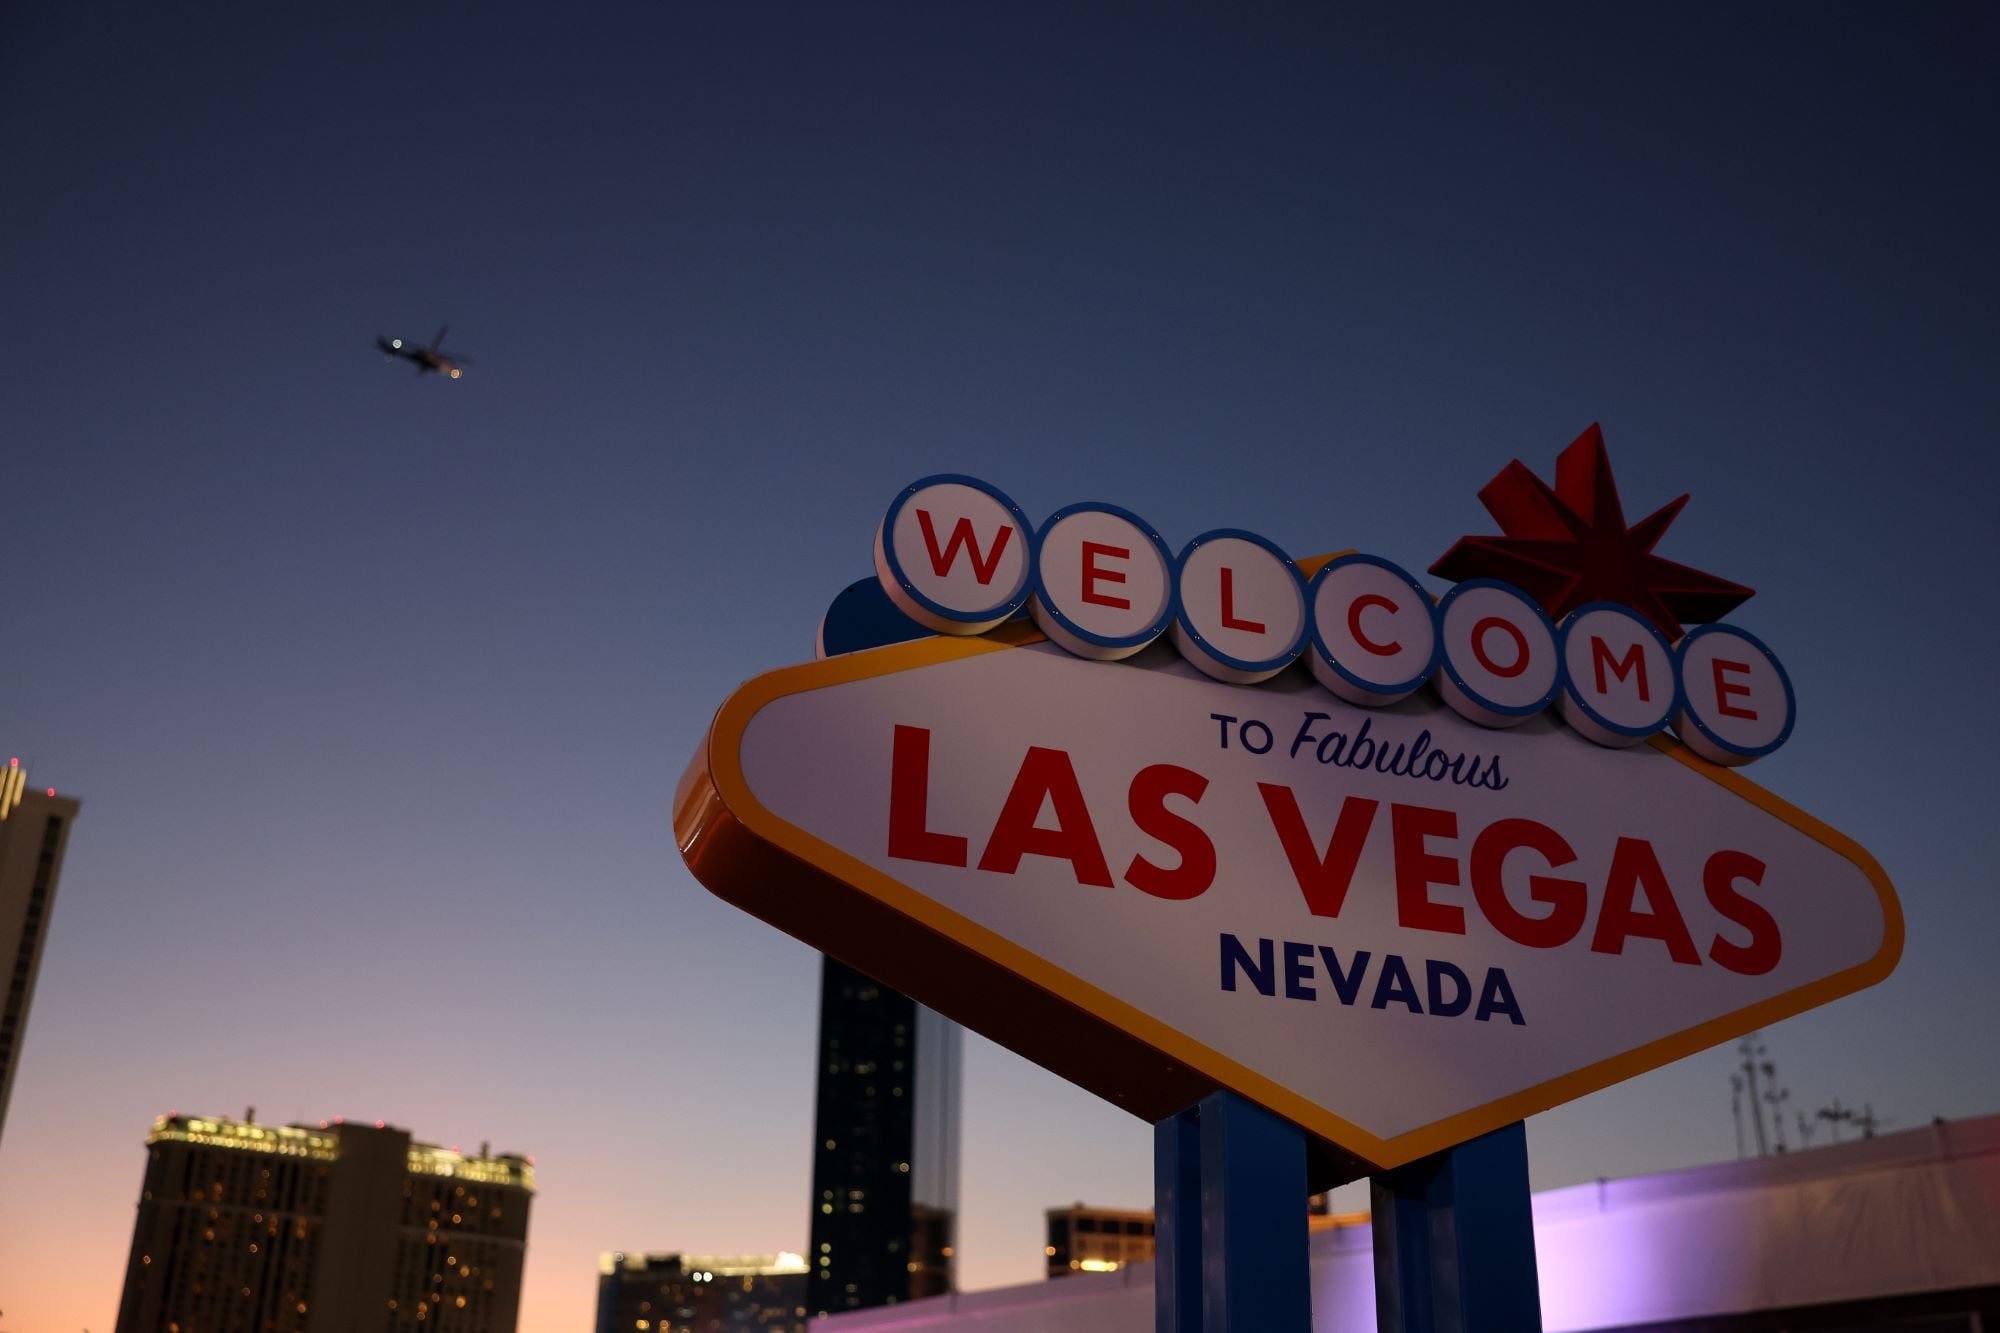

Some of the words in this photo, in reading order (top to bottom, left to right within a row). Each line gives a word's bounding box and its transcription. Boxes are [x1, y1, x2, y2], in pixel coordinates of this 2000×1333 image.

[916, 509, 1759, 721] WELCOME
[1210, 712, 1274, 755] TO
[1290, 711, 1509, 791] Fabulous
[887, 724, 1218, 901] LAS
[1256, 781, 1783, 976] VEGAS
[1219, 932, 1527, 1027] NEVADA
